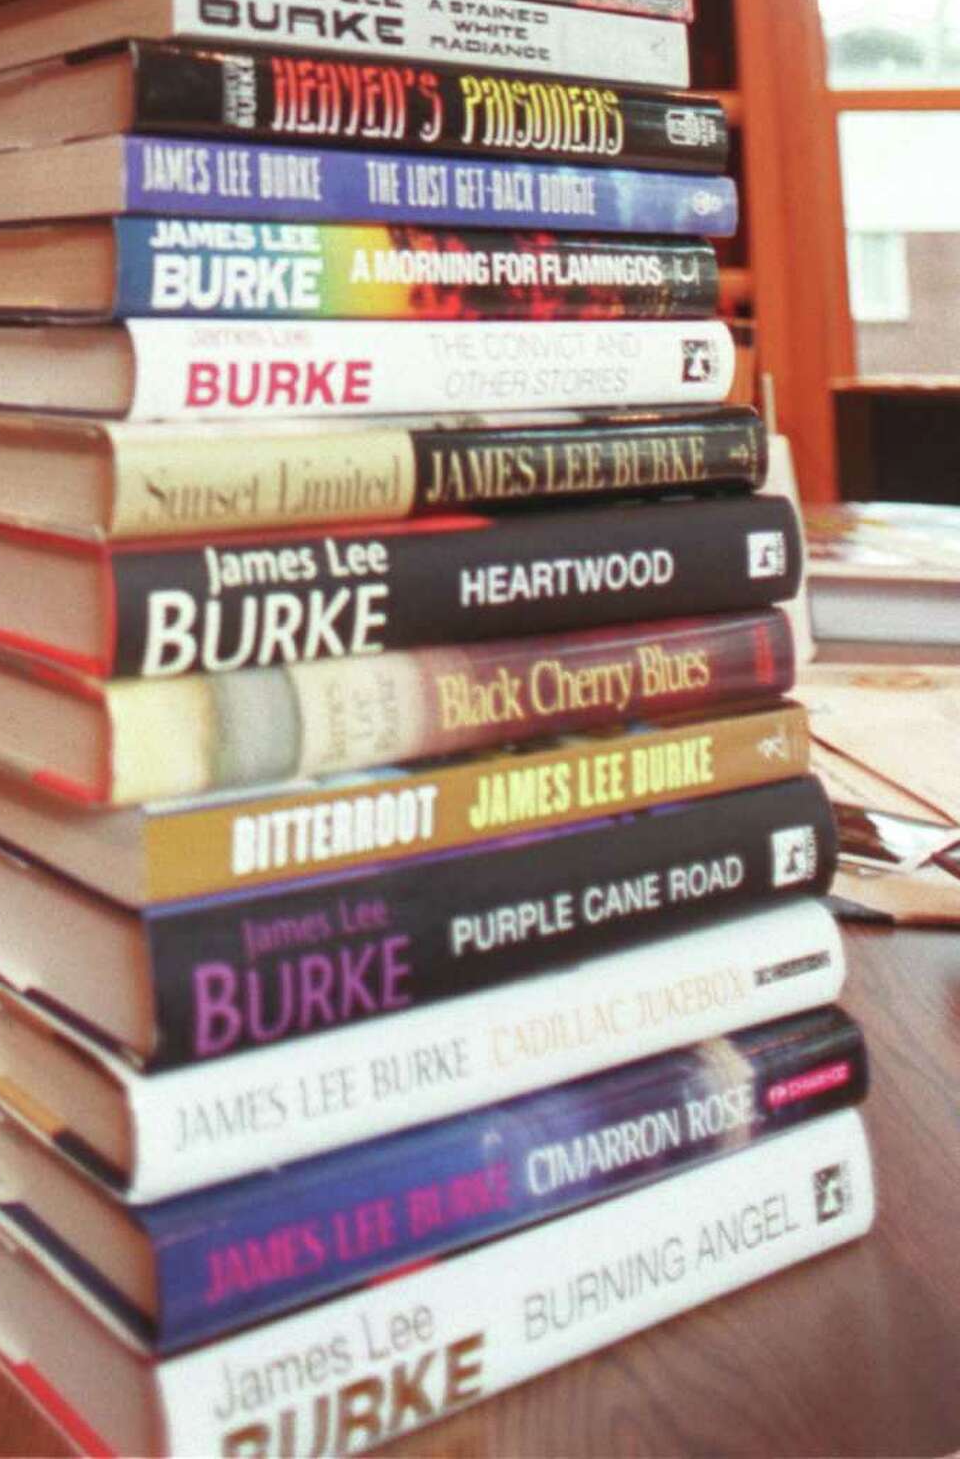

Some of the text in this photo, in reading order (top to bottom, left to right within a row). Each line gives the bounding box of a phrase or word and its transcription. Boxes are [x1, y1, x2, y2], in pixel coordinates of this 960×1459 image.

[448, 0, 550, 26] STAINED
[451, 19, 530, 41] WHITE
[428, 35, 552, 62] RADIANCE
[270, 55, 444, 142] HEAVEN'S
[458, 74, 625, 157] PRISONERS
[142, 144, 323, 202] JAMES LEE BURKE
[365, 160, 598, 217] THE LOST GET-BACK BOOGIE
[149, 218, 322, 253] JAMES LEE
[349, 249, 664, 286] A MORNING FOR FLAMINGOS
[150, 252, 325, 312] BURKE
[429, 333, 480, 361] THE
[184, 359, 374, 409] BURKE
[445, 367, 632, 399] OTHER STORIES
[141, 454, 403, 525] Sunset Limited
[426, 445, 538, 503] JAMES
[546, 440, 607, 492] LEE
[613, 435, 709, 489] BURKE
[204, 536, 390, 596] James Lee
[459, 548, 675, 608] HEARTWOOD
[141, 582, 390, 679] BURKE
[438, 667, 524, 730] Black
[530, 659, 635, 713] Cherry
[636, 642, 711, 697] Blues
[469, 736, 715, 830] JAMES LEE BURKE
[231, 783, 438, 876] BITTERROOT
[242, 898, 389, 960] James Lee
[450, 855, 744, 957] PURPLE CANE ROAD
[193, 933, 413, 1057] BURKE
[490, 997, 626, 1068] CADILLAC
[632, 967, 749, 1029] JUKEBOX
[174, 1038, 471, 1152] JAMES LEE BURKE
[525, 1084, 756, 1197] CIMARRON ROSE
[203, 1160, 514, 1307] JAMES LEE BURKE
[523, 1193, 802, 1343] BURNING ANGEL
[212, 1303, 436, 1421] James Lee
